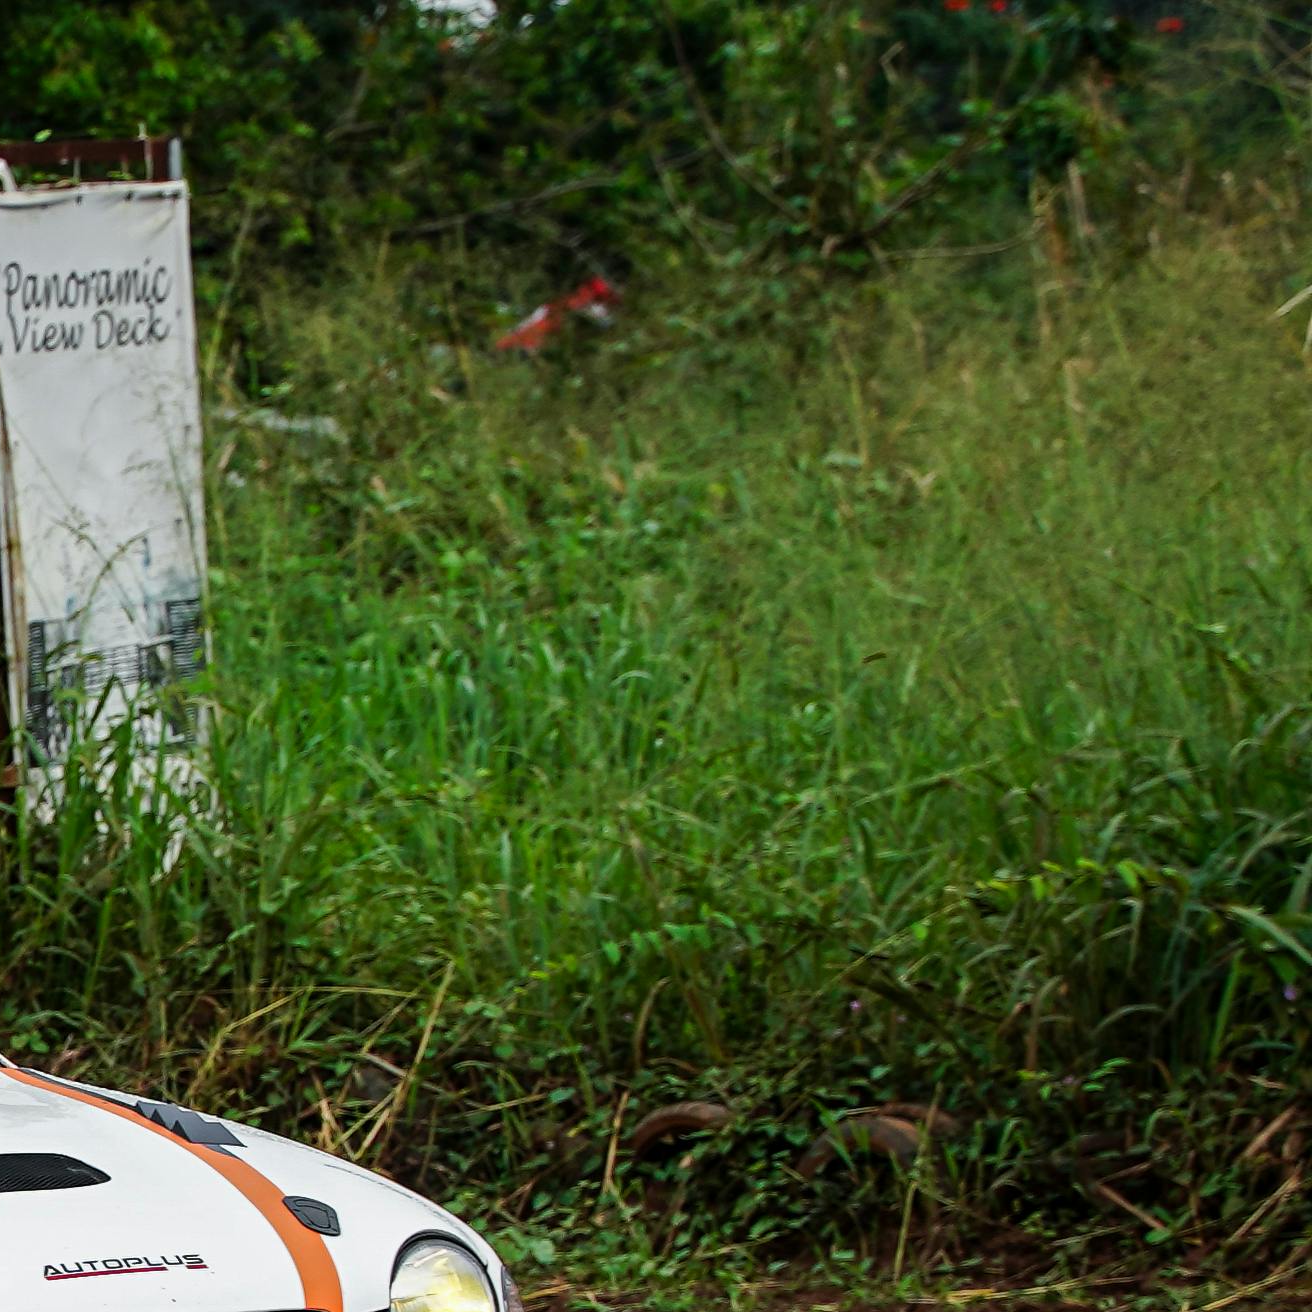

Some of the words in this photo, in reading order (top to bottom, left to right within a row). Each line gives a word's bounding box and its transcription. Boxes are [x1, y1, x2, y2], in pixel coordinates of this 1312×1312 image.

[3, 255, 173, 315] Panoramic
[9, 311, 85, 353] View
[91, 302, 172, 350] Deck
[43, 1253, 205, 1278] AUTOPLUS
